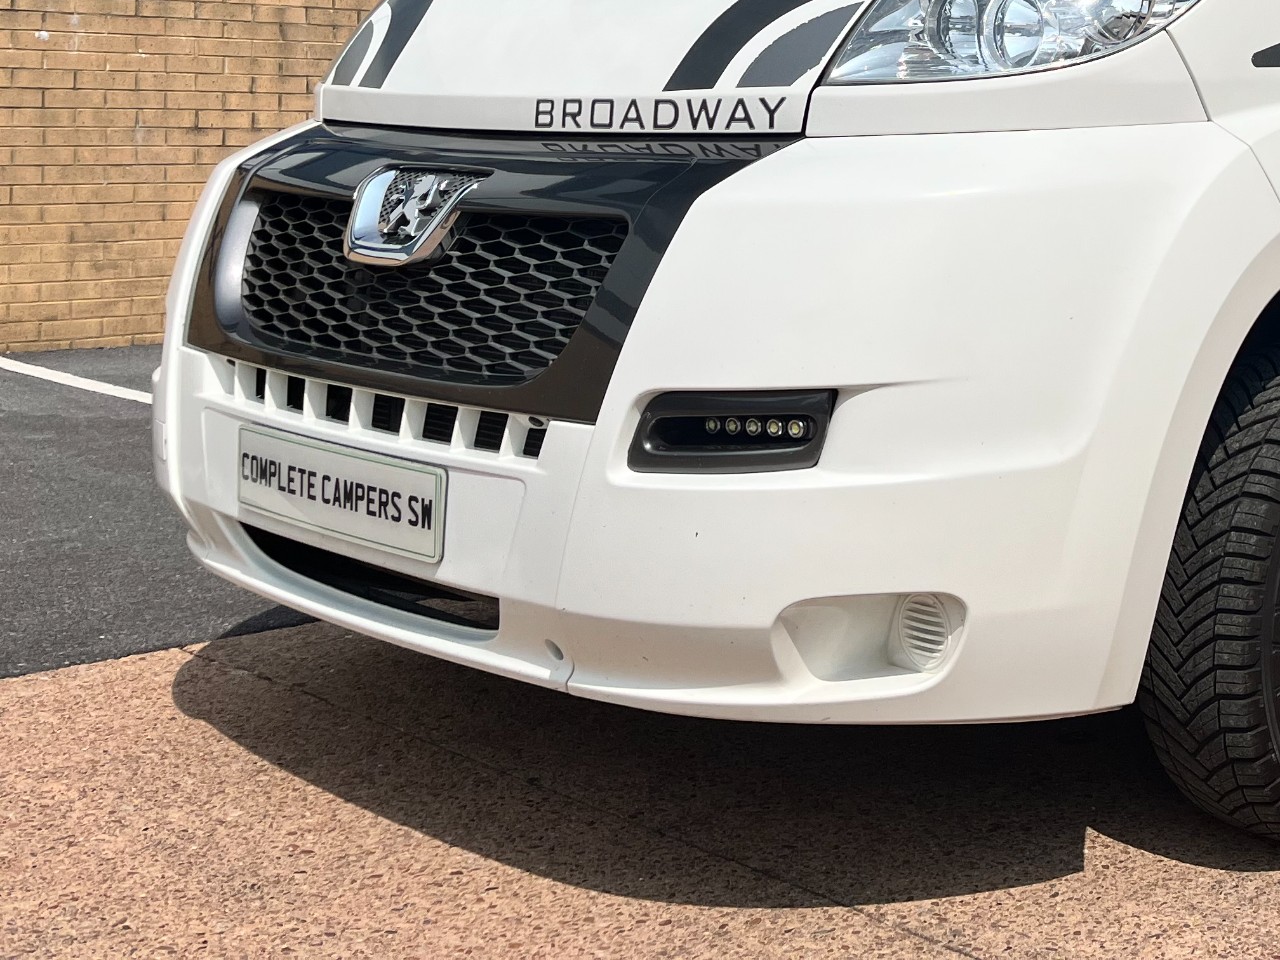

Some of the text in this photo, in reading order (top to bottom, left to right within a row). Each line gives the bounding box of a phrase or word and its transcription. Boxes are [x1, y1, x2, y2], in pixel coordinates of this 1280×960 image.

[535, 96, 787, 130] BROADWAY
[241, 452, 433, 531] COMPLETE CAMPERS SW
